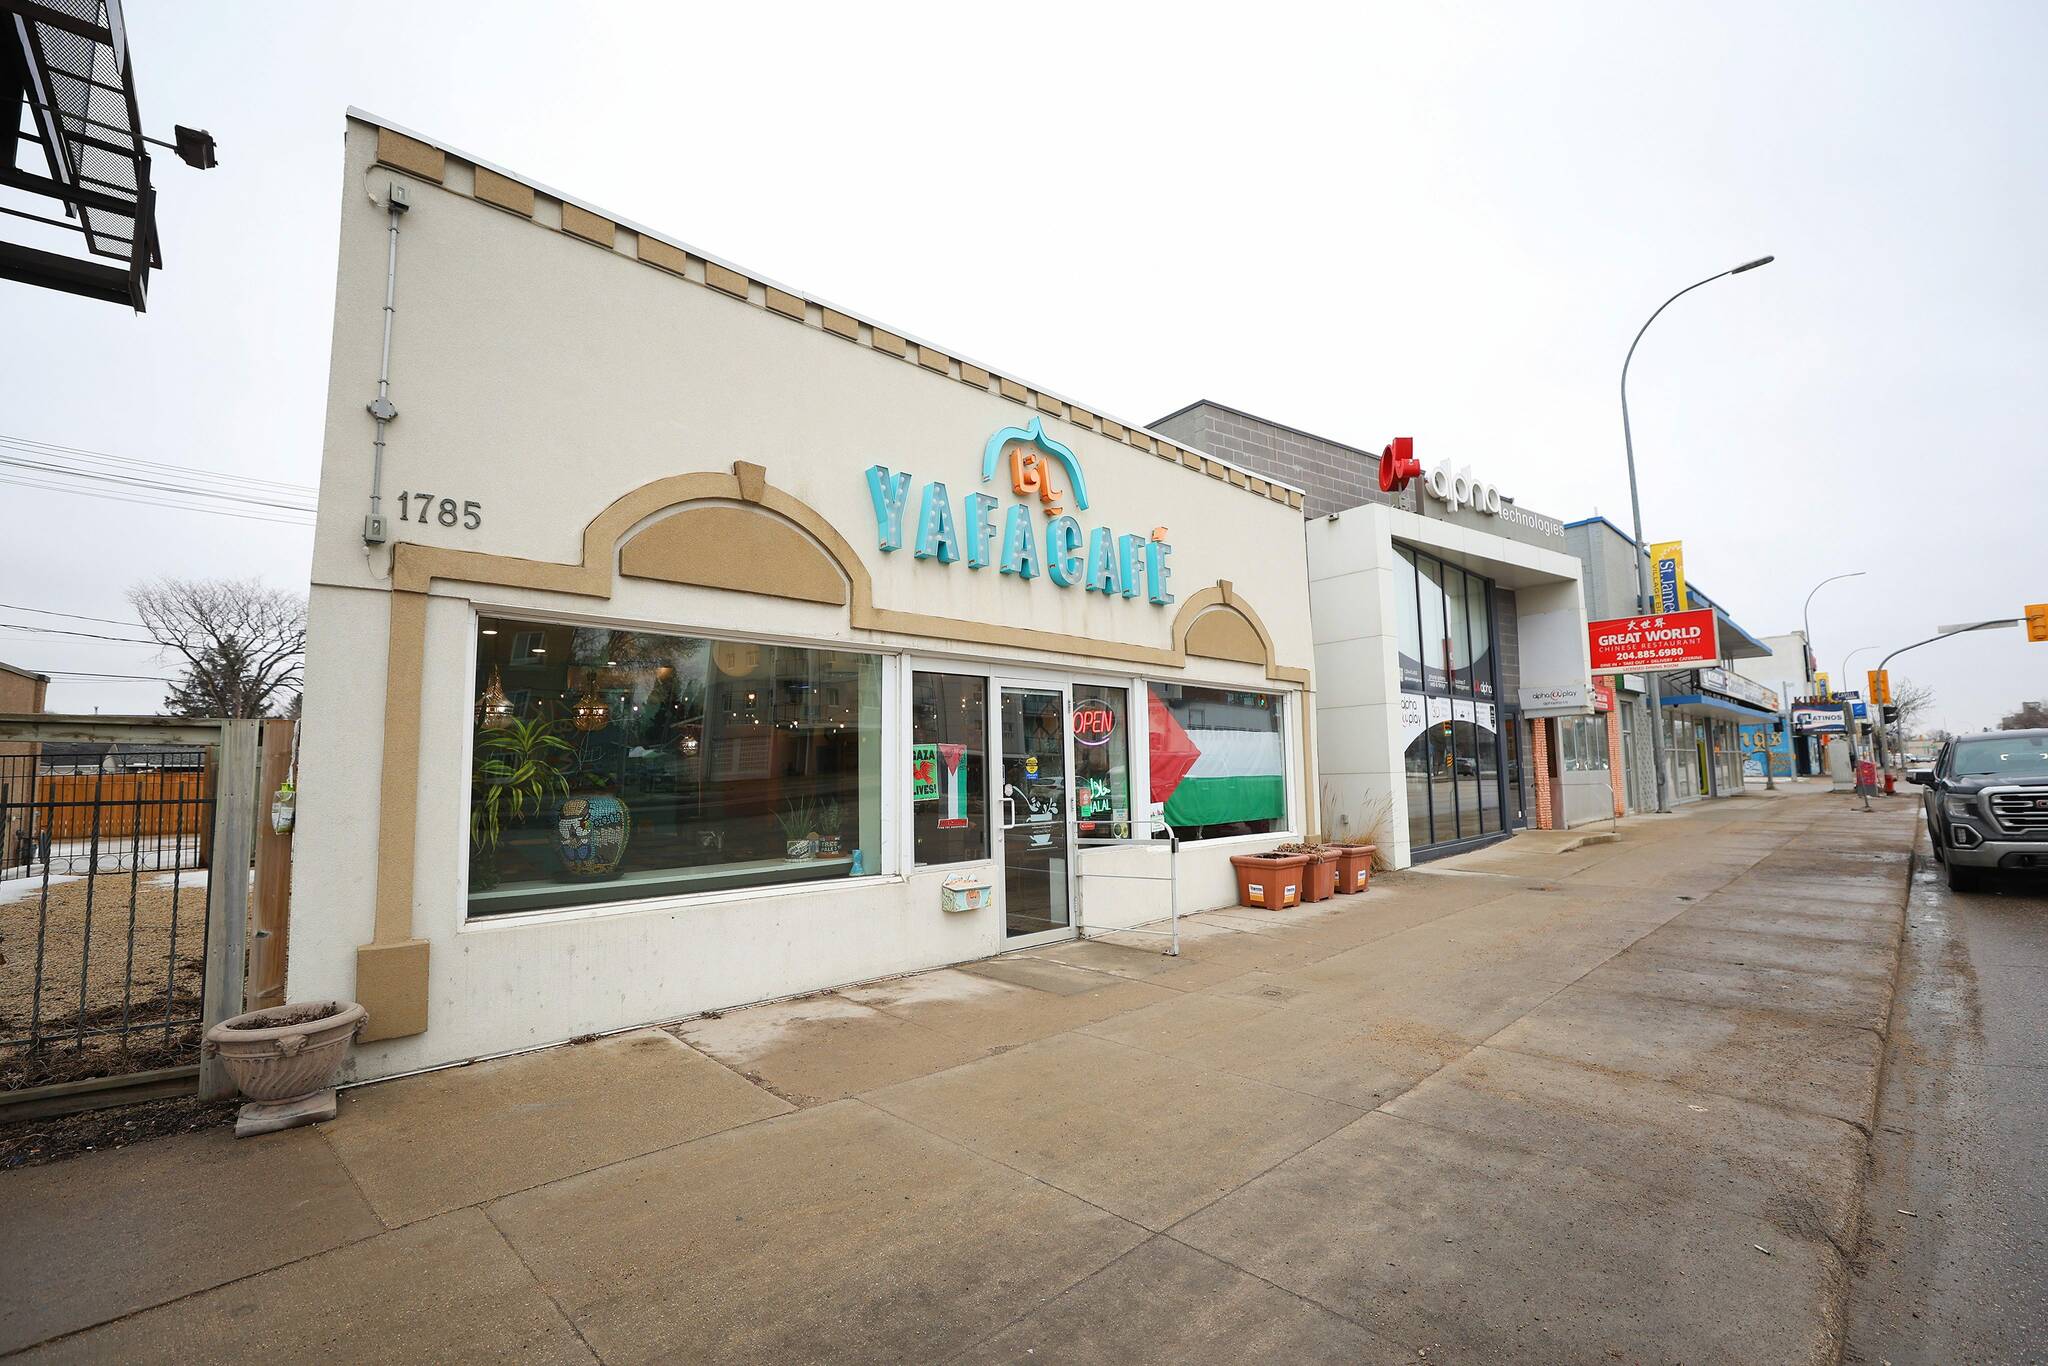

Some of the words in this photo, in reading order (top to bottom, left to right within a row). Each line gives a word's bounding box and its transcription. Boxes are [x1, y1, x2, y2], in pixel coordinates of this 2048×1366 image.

[1425, 457, 1501, 513] alpha
[397, 490, 482, 530] 1785
[1499, 507, 1565, 538] technologies
[1652, 563, 1660, 601] VILLAGE
[1627, 617, 1666, 631] 大世界
[1598, 632, 1642, 646] GREAT
[1645, 626, 1701, 642] WORLD
[1599, 643, 1637, 653] CHINESE
[1641, 638, 1701, 649] RESTAURANT
[1616, 647, 1684, 660] 204.885.6980
[1532, 691, 1550, 700] alpha
[1562, 689, 1577, 698] play
[1072, 710, 1113, 734] OPEN
